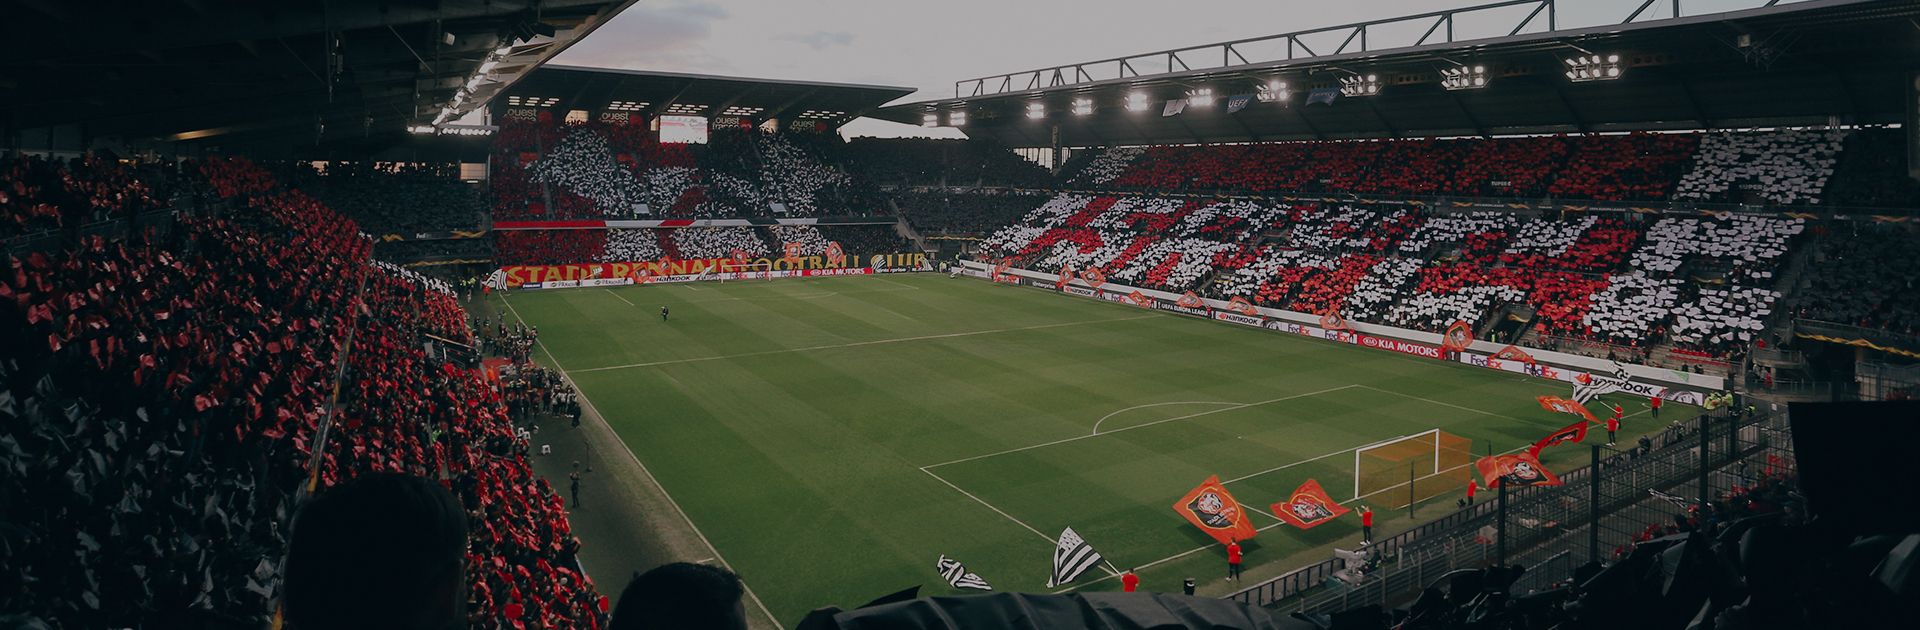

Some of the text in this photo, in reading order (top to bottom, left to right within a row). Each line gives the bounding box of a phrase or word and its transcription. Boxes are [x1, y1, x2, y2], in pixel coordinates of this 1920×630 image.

[507, 108, 537, 117] ouest
[602, 112, 629, 120] ouest
[507, 264, 603, 287] STADE
[1288, 323, 1311, 336] FedEx
[1325, 329, 1349, 342] FedEx
[1378, 339, 1395, 350] KIA
[1397, 342, 1439, 358] MOTORS
[1470, 354, 1502, 370] FedEx
